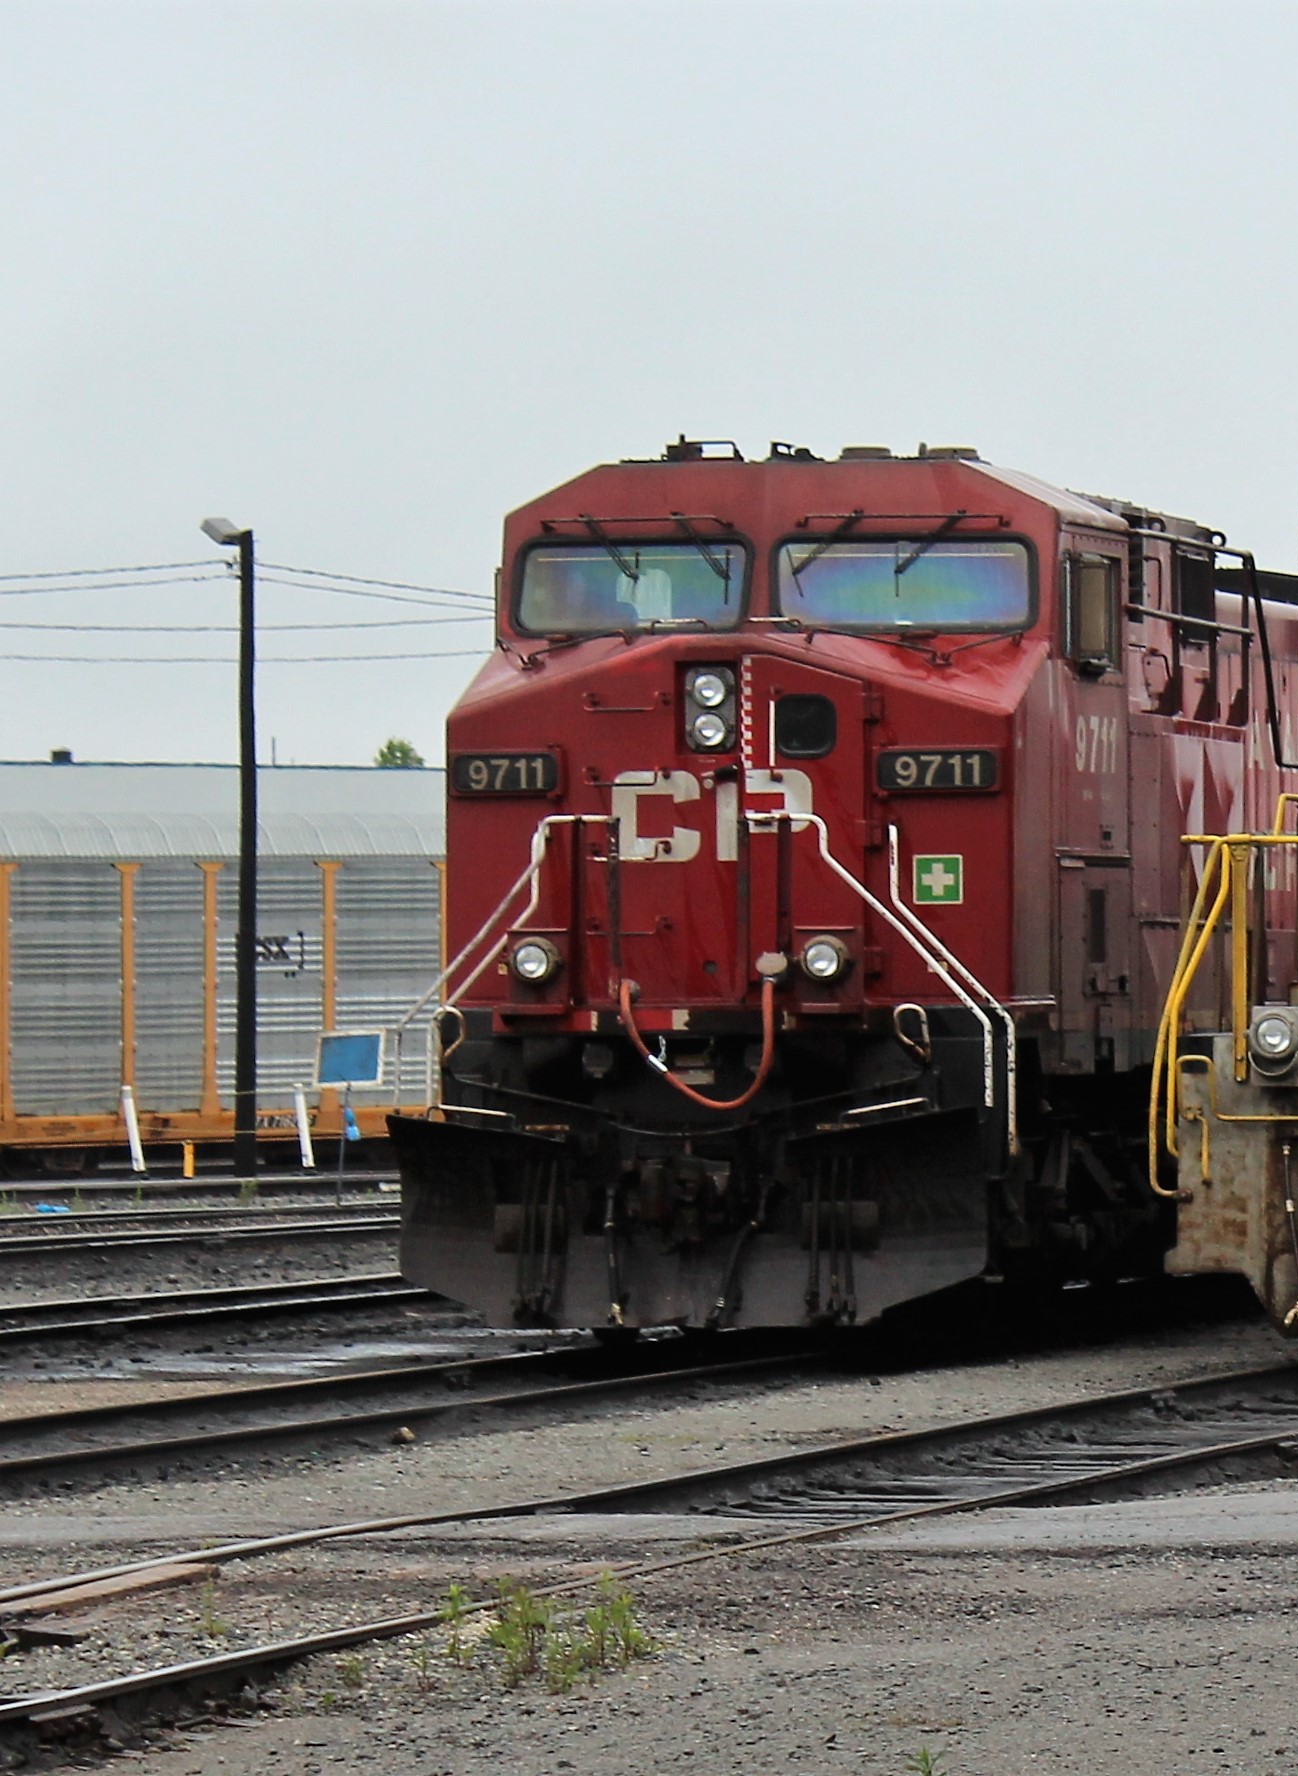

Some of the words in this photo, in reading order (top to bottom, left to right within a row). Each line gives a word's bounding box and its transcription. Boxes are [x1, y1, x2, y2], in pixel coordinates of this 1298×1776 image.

[1075, 714, 1118, 774] 9711
[468, 758, 545, 790] 9711
[894, 754, 981, 787] 9711
[611, 768, 813, 862] CP
